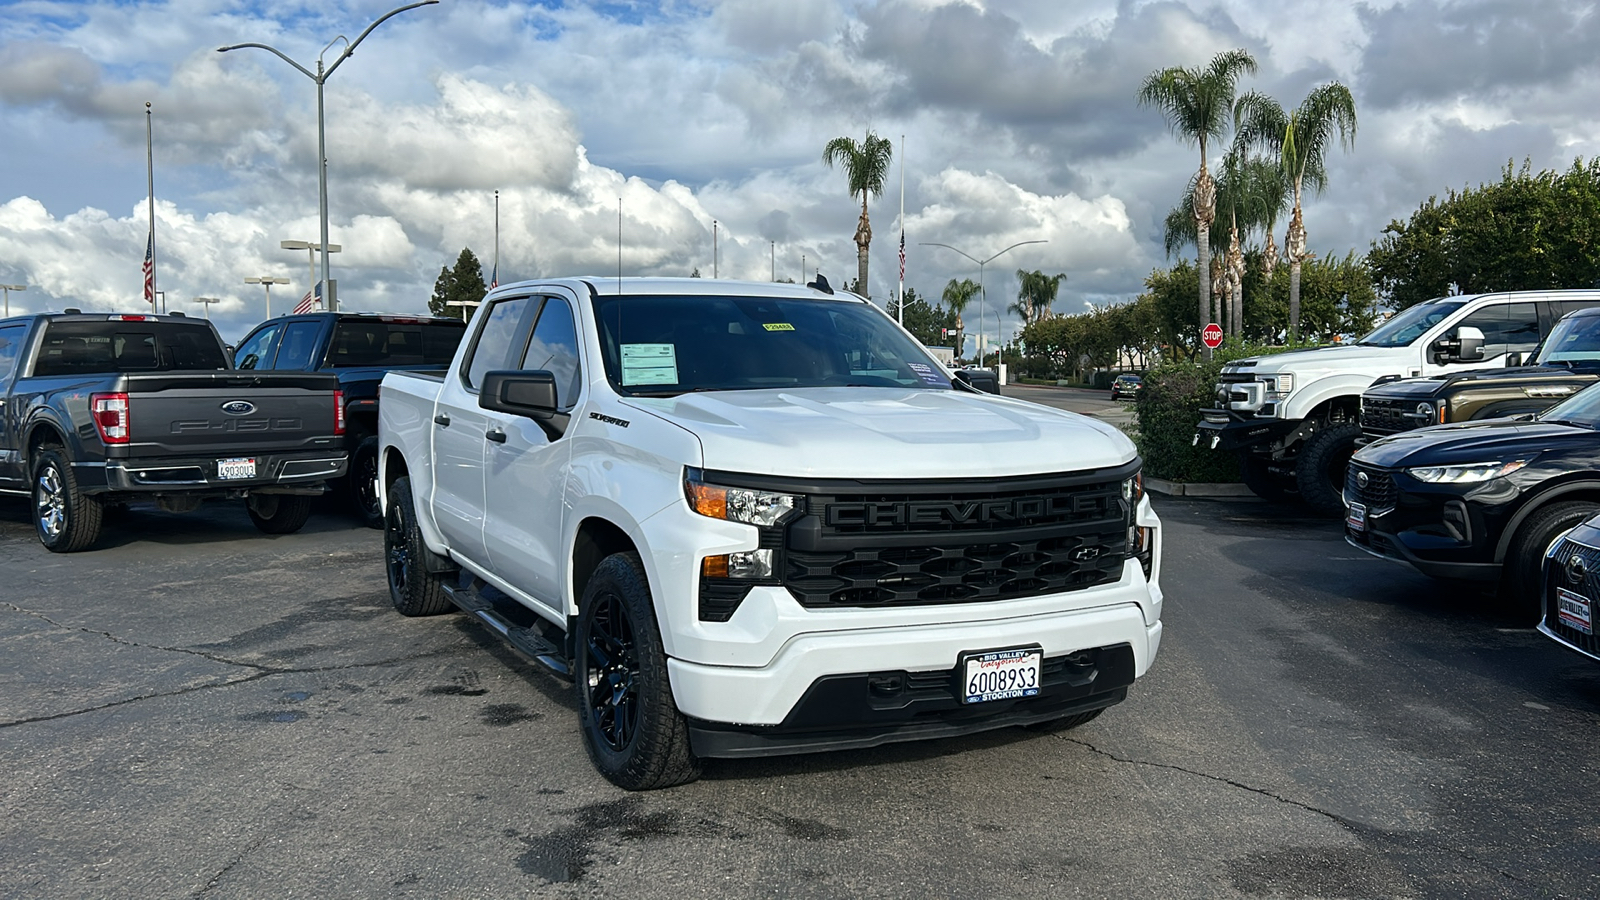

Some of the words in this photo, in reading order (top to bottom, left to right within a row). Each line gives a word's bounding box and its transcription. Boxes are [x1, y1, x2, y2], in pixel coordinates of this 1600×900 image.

[1204, 331, 1221, 340] STOP
[171, 418, 303, 433] F-150
[589, 412, 630, 428] SILVERADO
[825, 489, 1120, 527] CHEVROLET
[969, 667, 1036, 694] 60089S3
[982, 690, 1023, 701] STOCKTON
